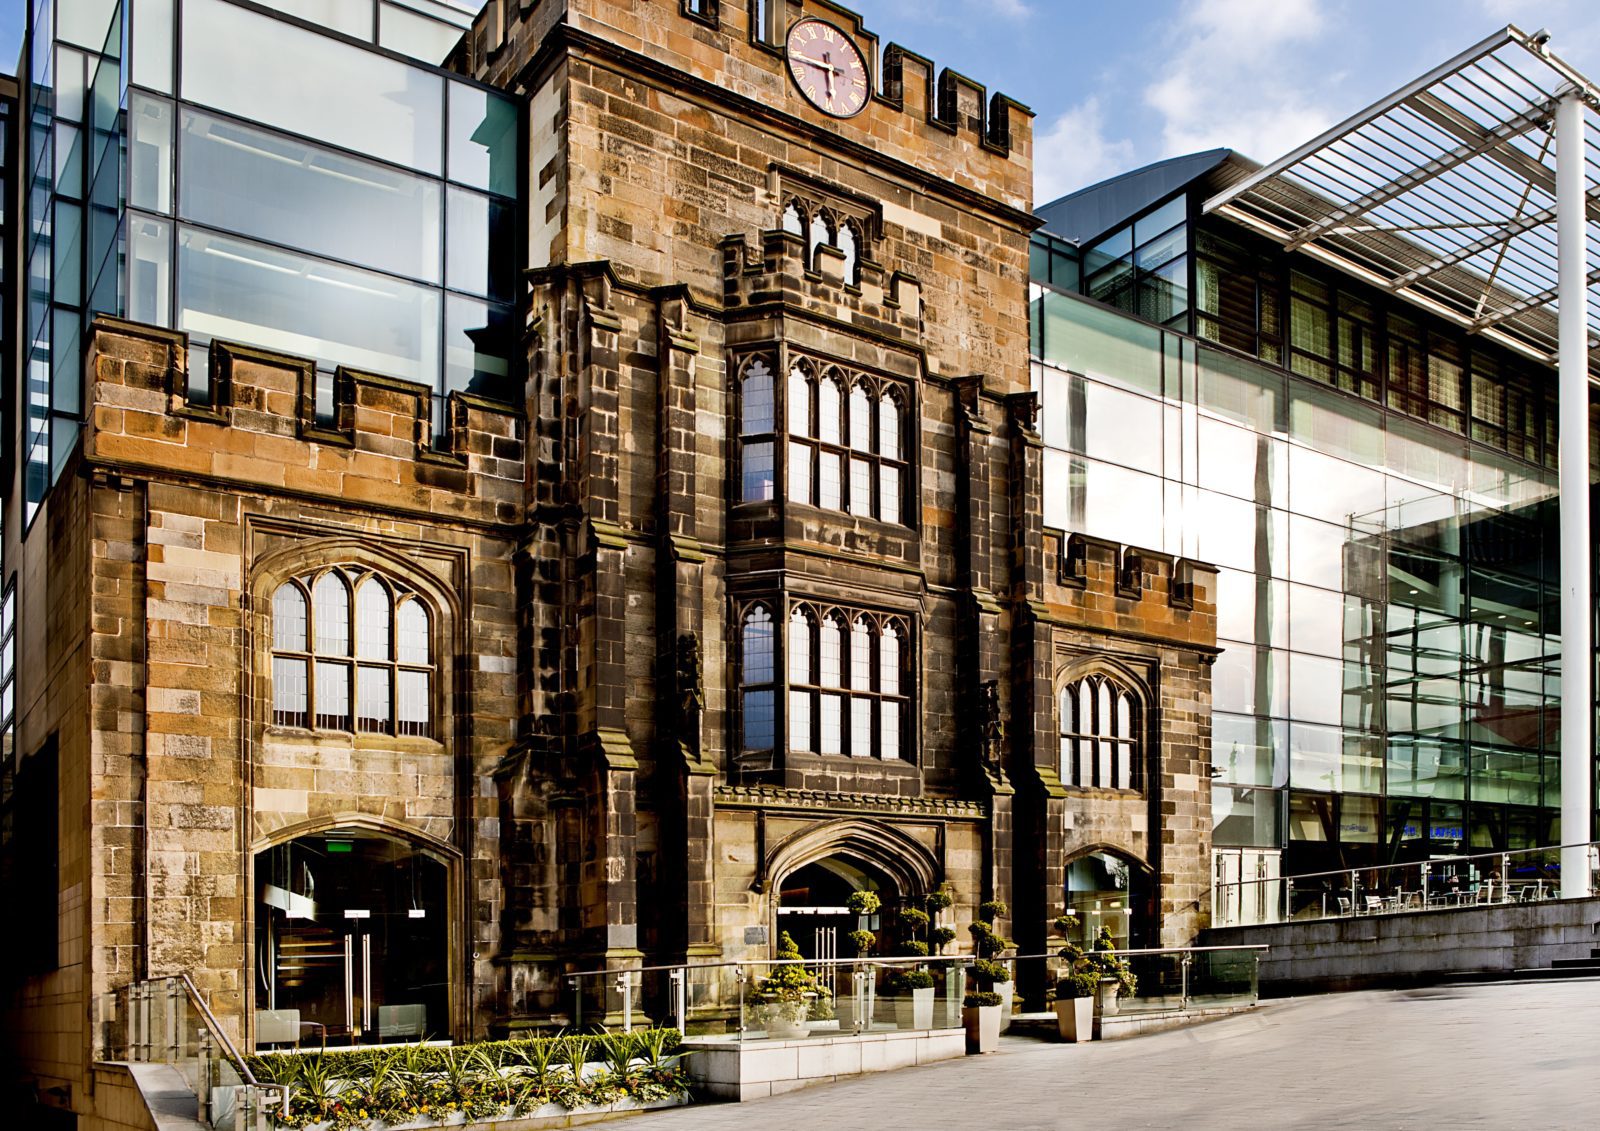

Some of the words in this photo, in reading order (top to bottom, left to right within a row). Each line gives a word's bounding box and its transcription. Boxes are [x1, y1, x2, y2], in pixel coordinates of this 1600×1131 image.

[794, 32, 807, 46] X
[823, 26, 834, 43] XII
[840, 40, 849, 53] I
[841, 102, 850, 114] V
